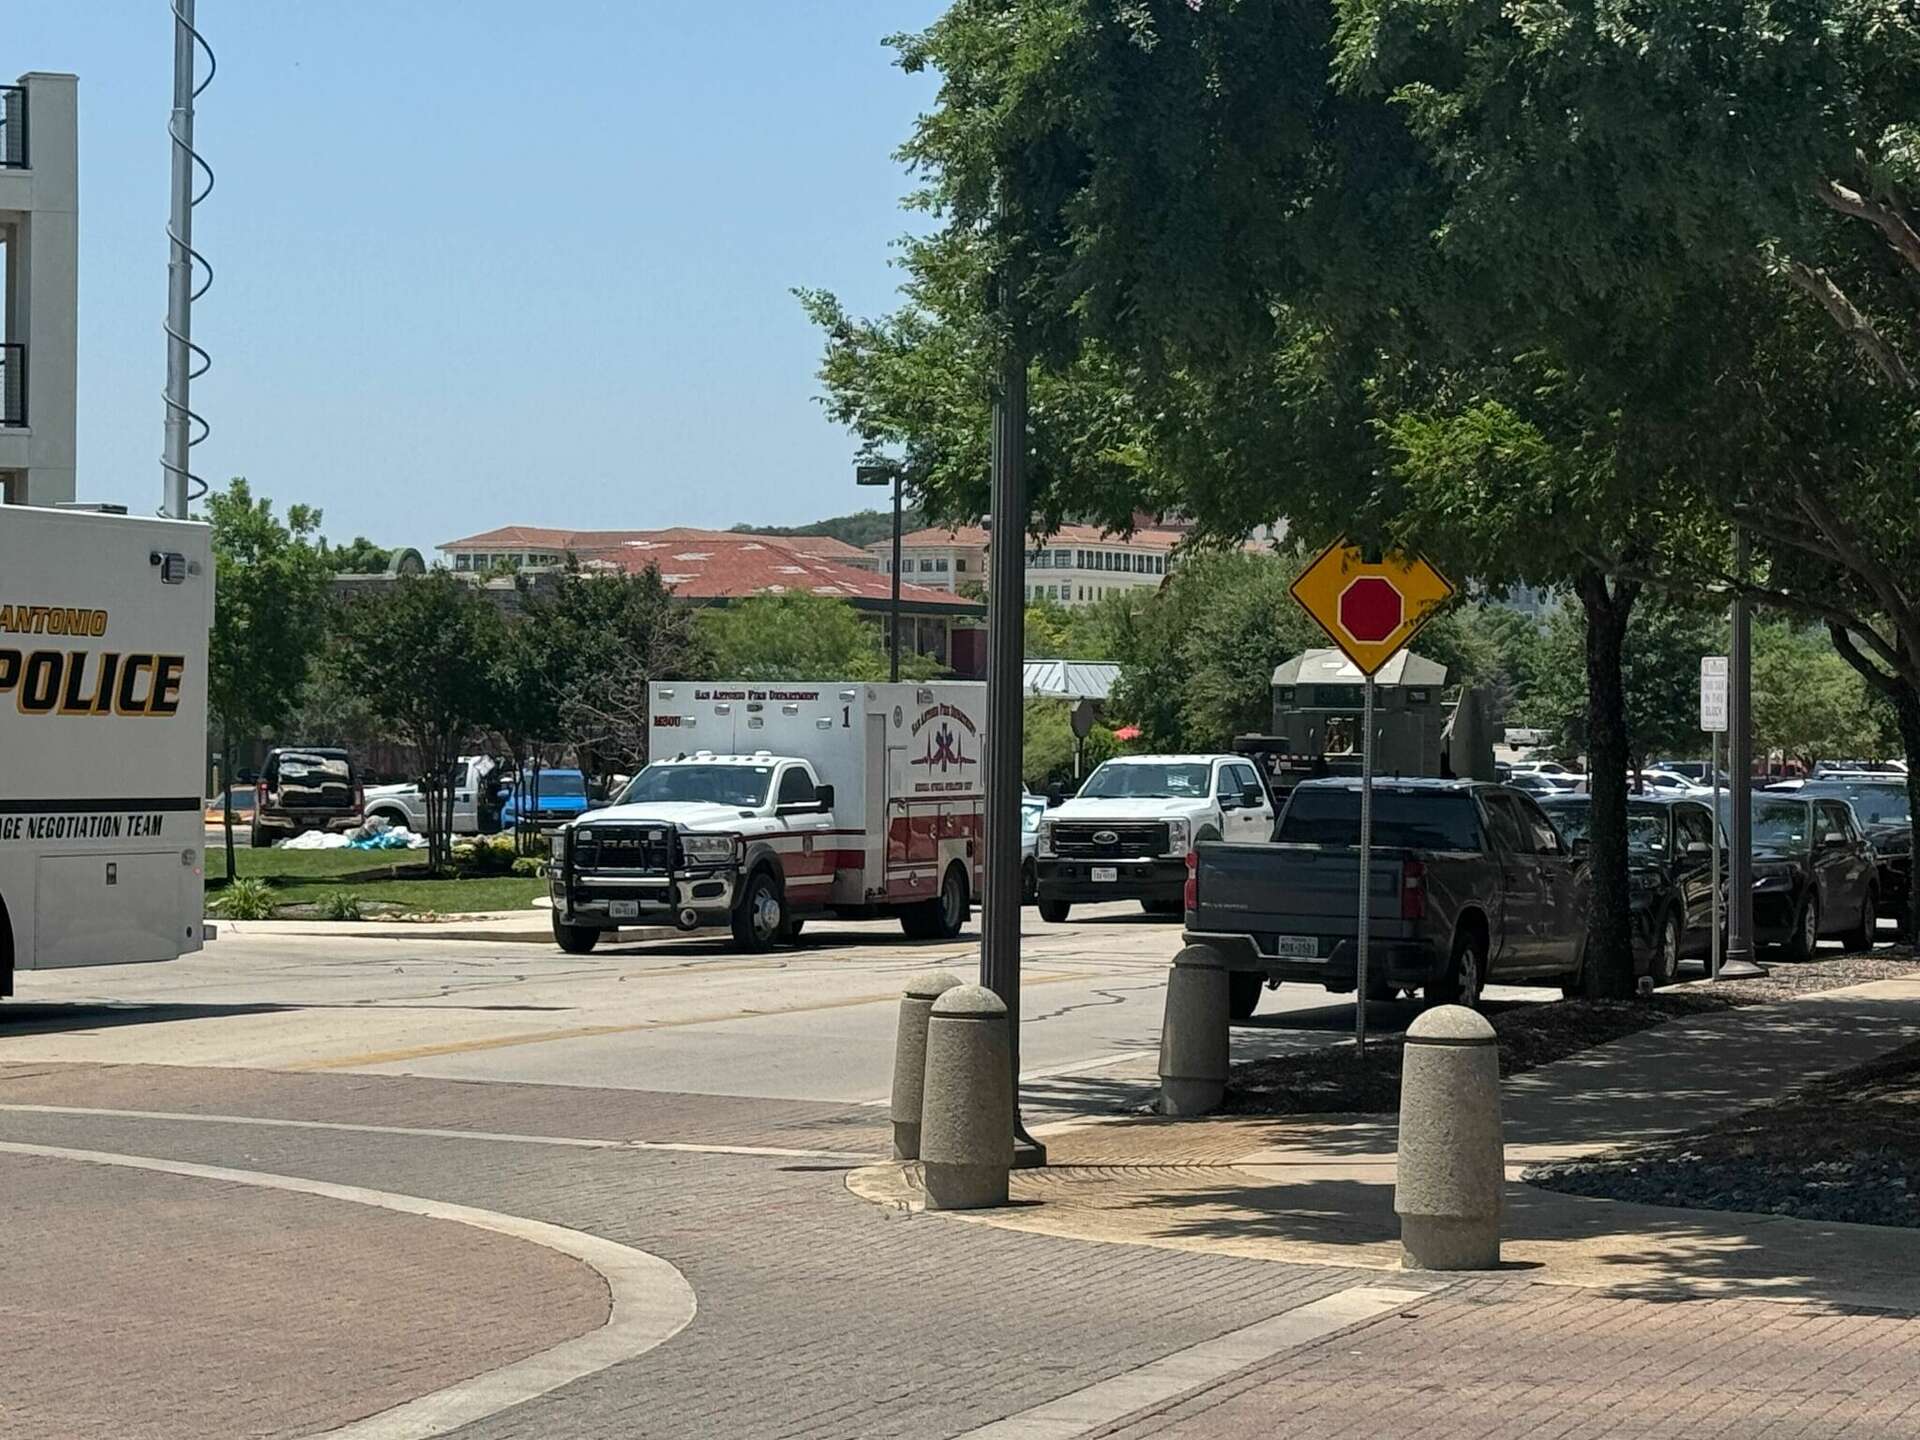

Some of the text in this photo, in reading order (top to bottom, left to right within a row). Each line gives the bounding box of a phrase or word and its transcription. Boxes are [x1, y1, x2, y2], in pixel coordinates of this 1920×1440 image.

[0, 604, 108, 637] ANTONIO
[842, 705, 851, 728] 1
[0, 815, 163, 840] GE NEGOTIATION TEAM
